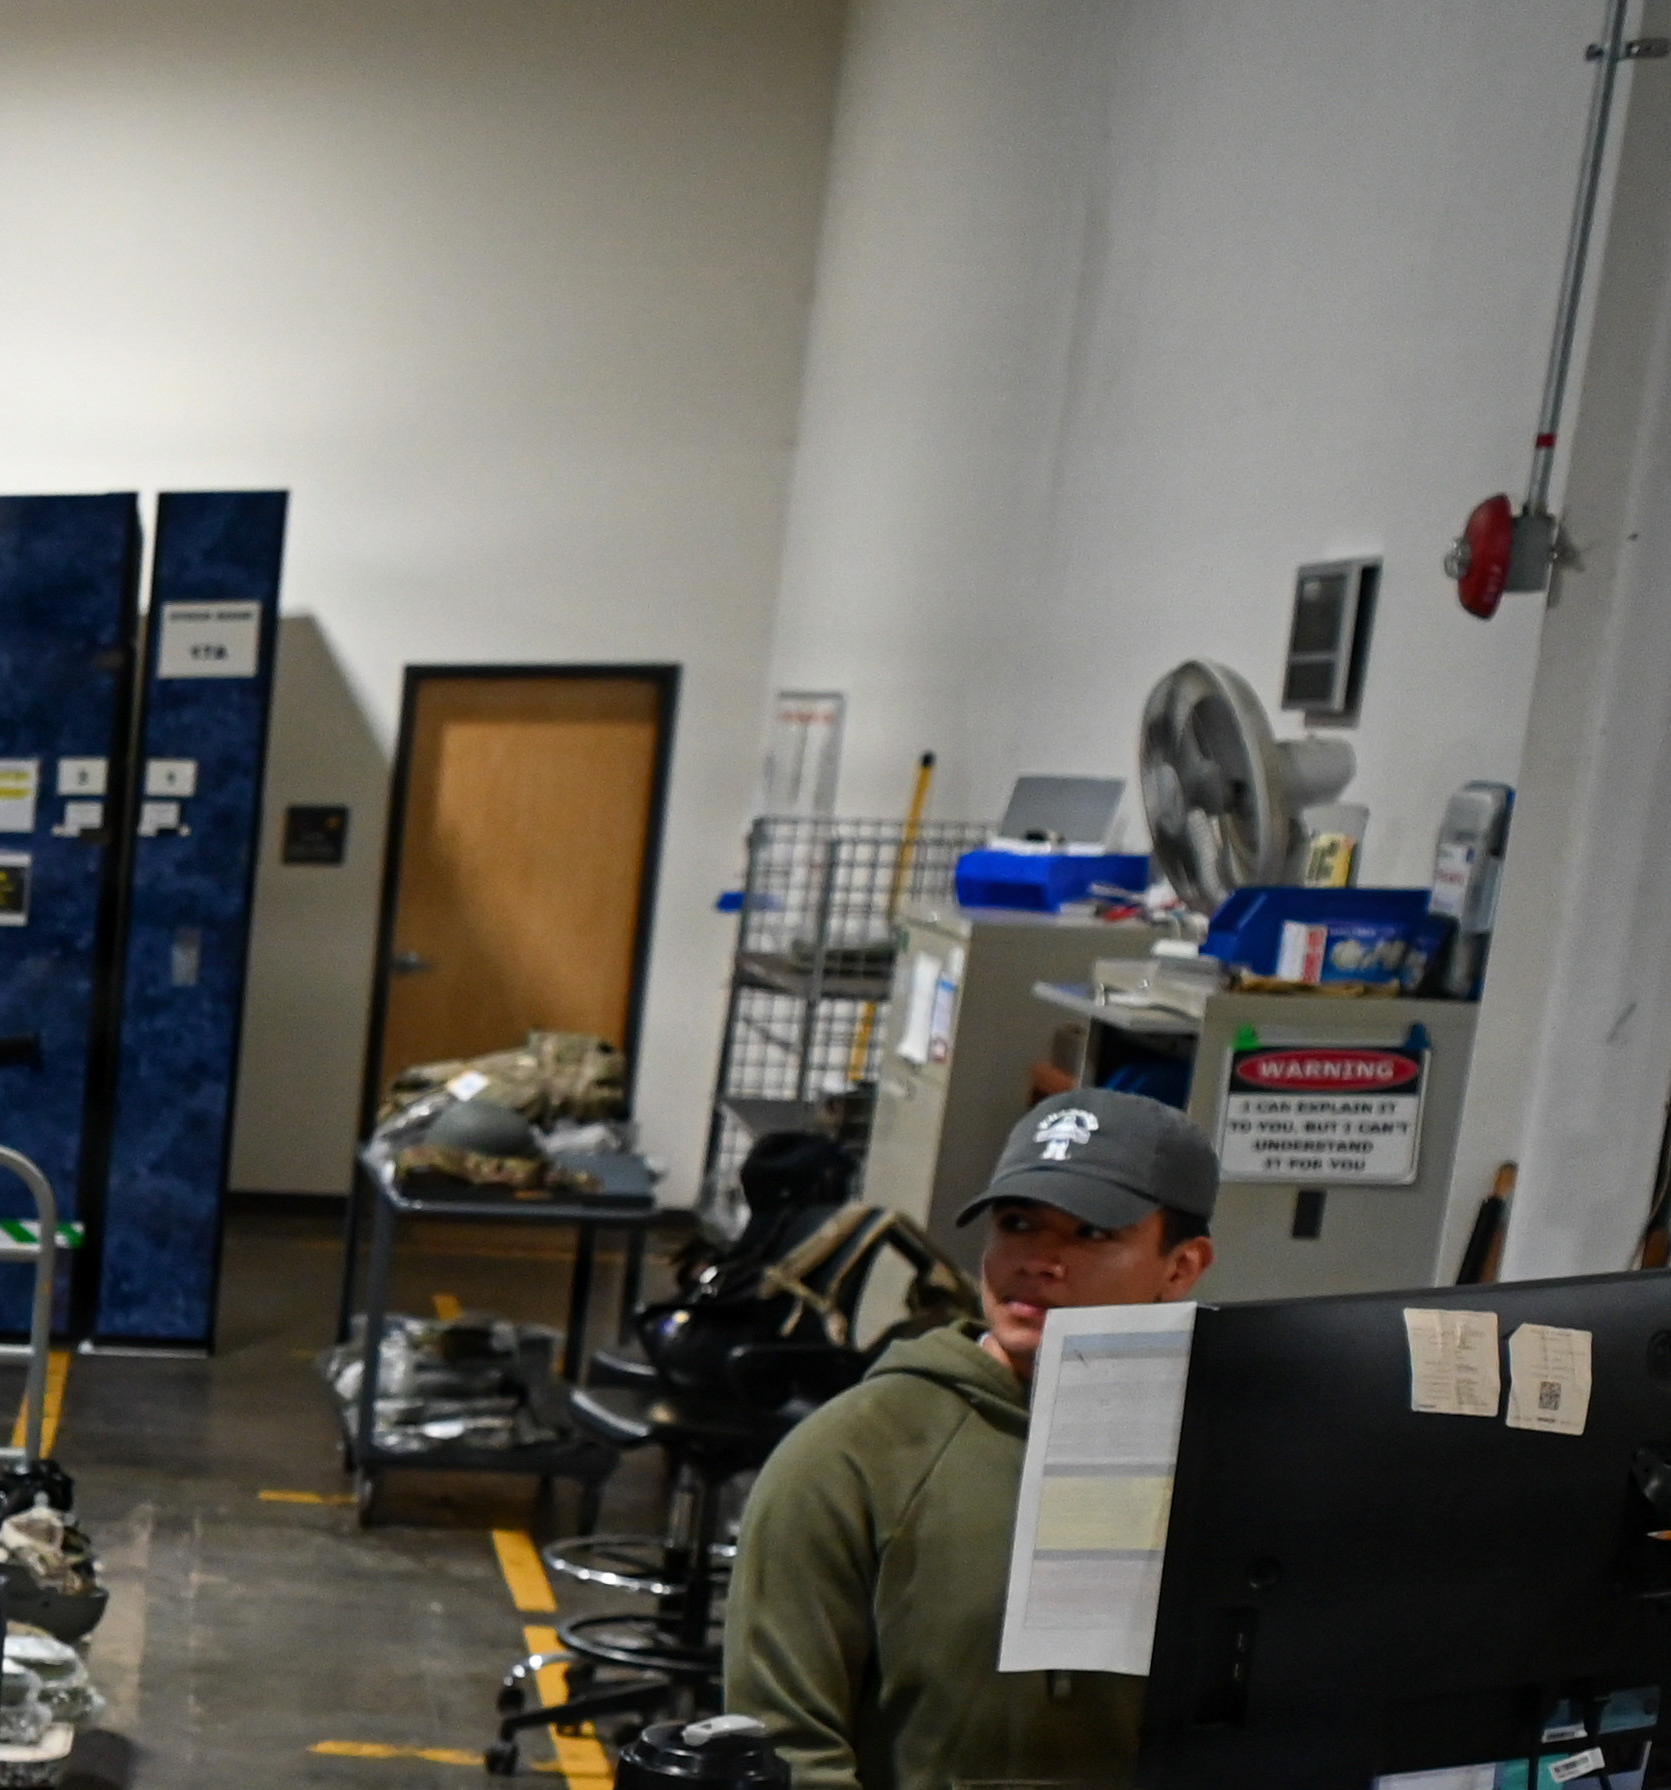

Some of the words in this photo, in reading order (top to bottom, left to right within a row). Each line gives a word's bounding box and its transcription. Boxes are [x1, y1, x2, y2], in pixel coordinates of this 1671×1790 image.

[1260, 1060, 1395, 1080] WARNING
[1257, 1101, 1292, 1113] CAN
[1297, 1101, 1373, 1114] EXPLAIN
[1378, 1101, 1396, 1113] IT
[1230, 1120, 1252, 1134] TO
[1303, 1120, 1338, 1134] BUT
[1358, 1120, 1409, 1134] CAN'T
[1253, 1139, 1374, 1154] UNDERSTAND
[1264, 1157, 1281, 1170] IT
[1289, 1157, 1323, 1170] FOR
[1329, 1156, 1366, 1170] YOU
